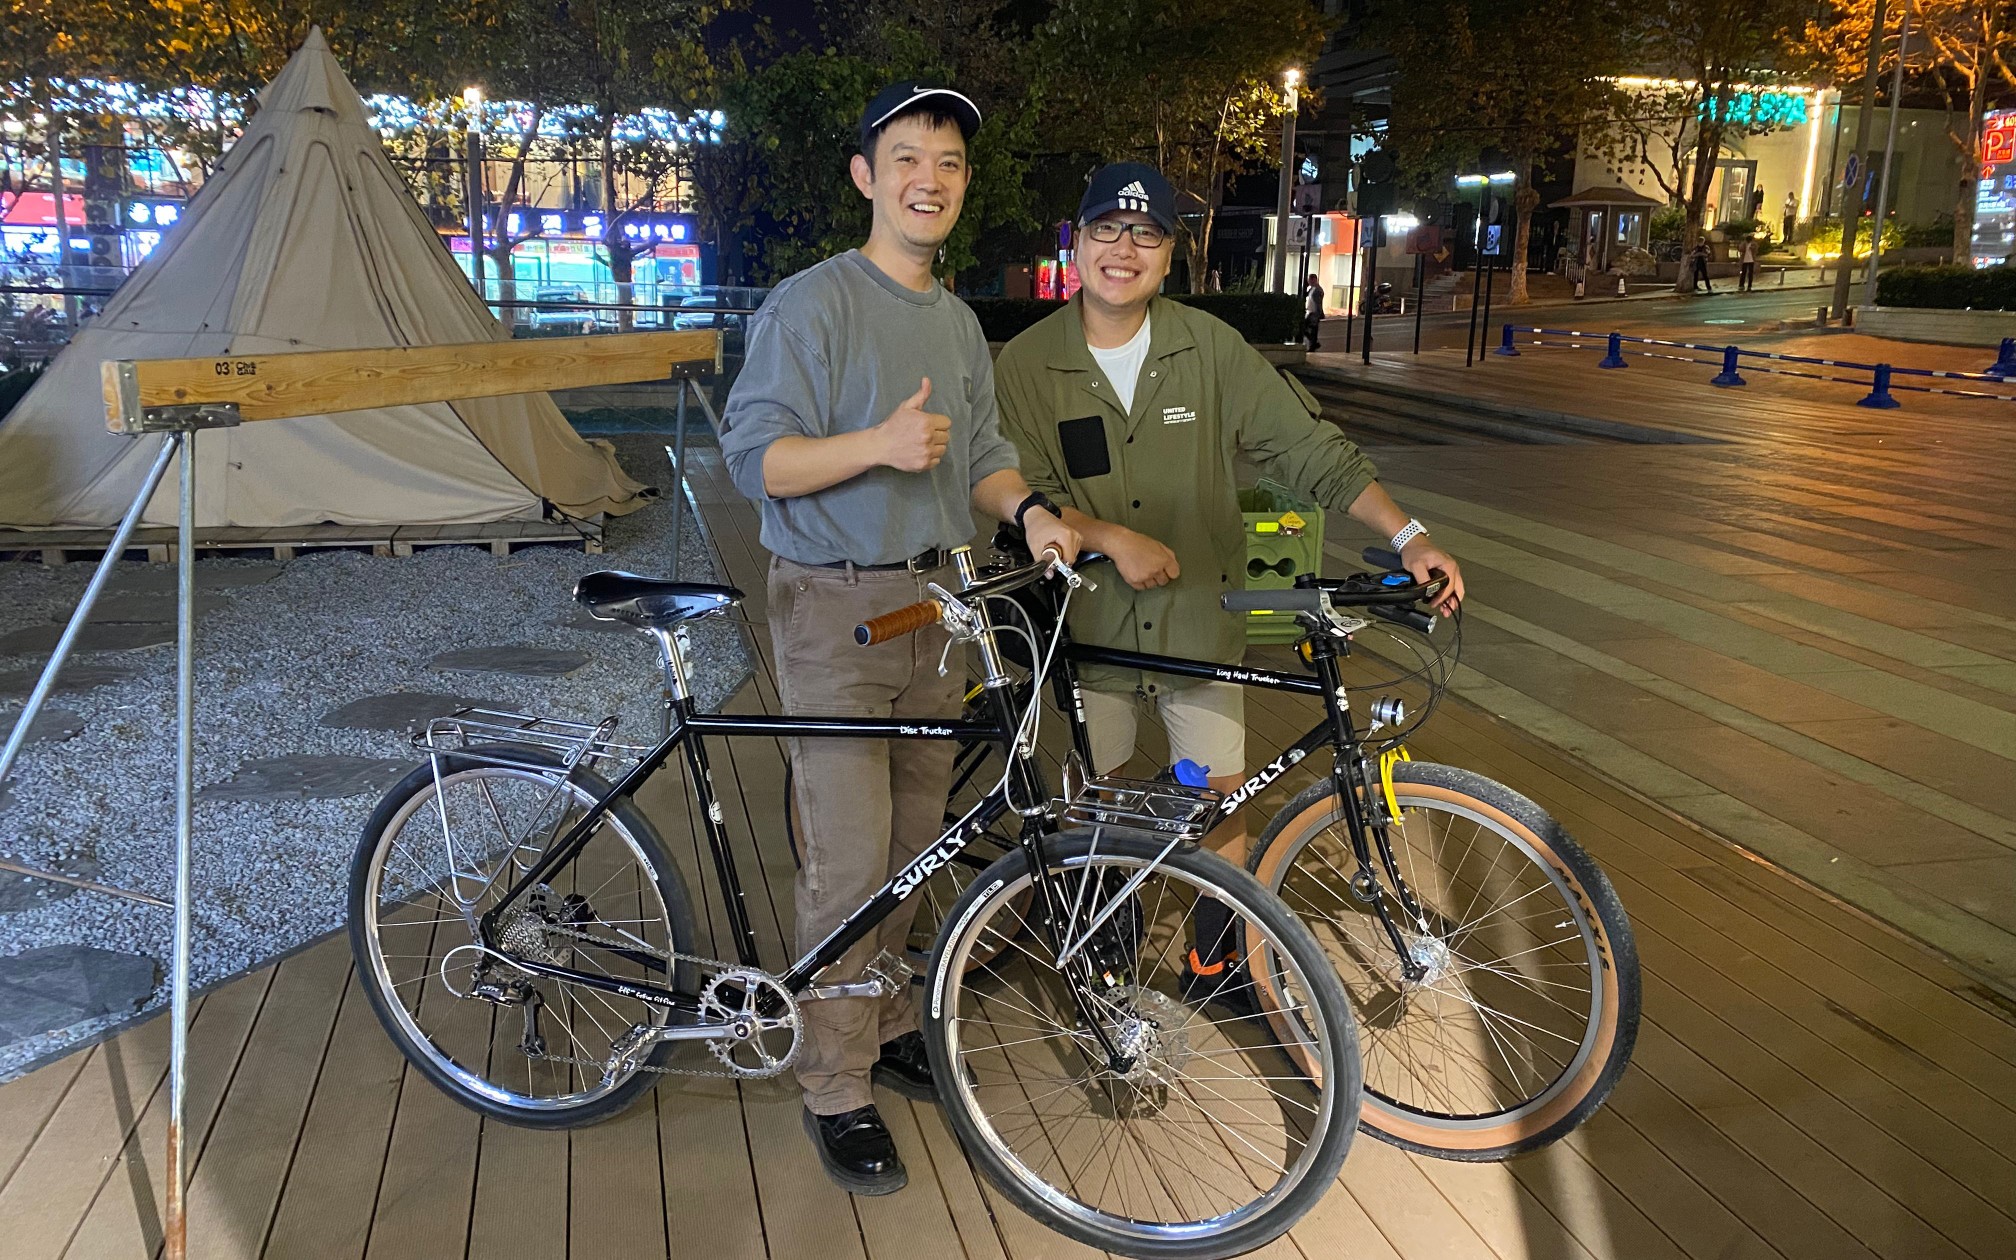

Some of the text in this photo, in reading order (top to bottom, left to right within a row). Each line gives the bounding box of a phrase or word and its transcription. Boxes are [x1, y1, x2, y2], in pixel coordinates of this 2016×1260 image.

[1756, 93, 1807, 125] SPA
[1986, 131, 2004, 160] P
[1117, 190, 1150, 201] adidas
[215, 361, 230, 375] 03
[1162, 406, 1186, 414] UNITED
[1163, 411, 1196, 421] LIFESTYLE
[1216, 668, 1231, 680] Long
[900, 725, 953, 736] Disc Trucker
[1220, 755, 1286, 816] SURLY
[892, 827, 967, 901] SURLY
[940, 931, 959, 973] GRAVELKING
